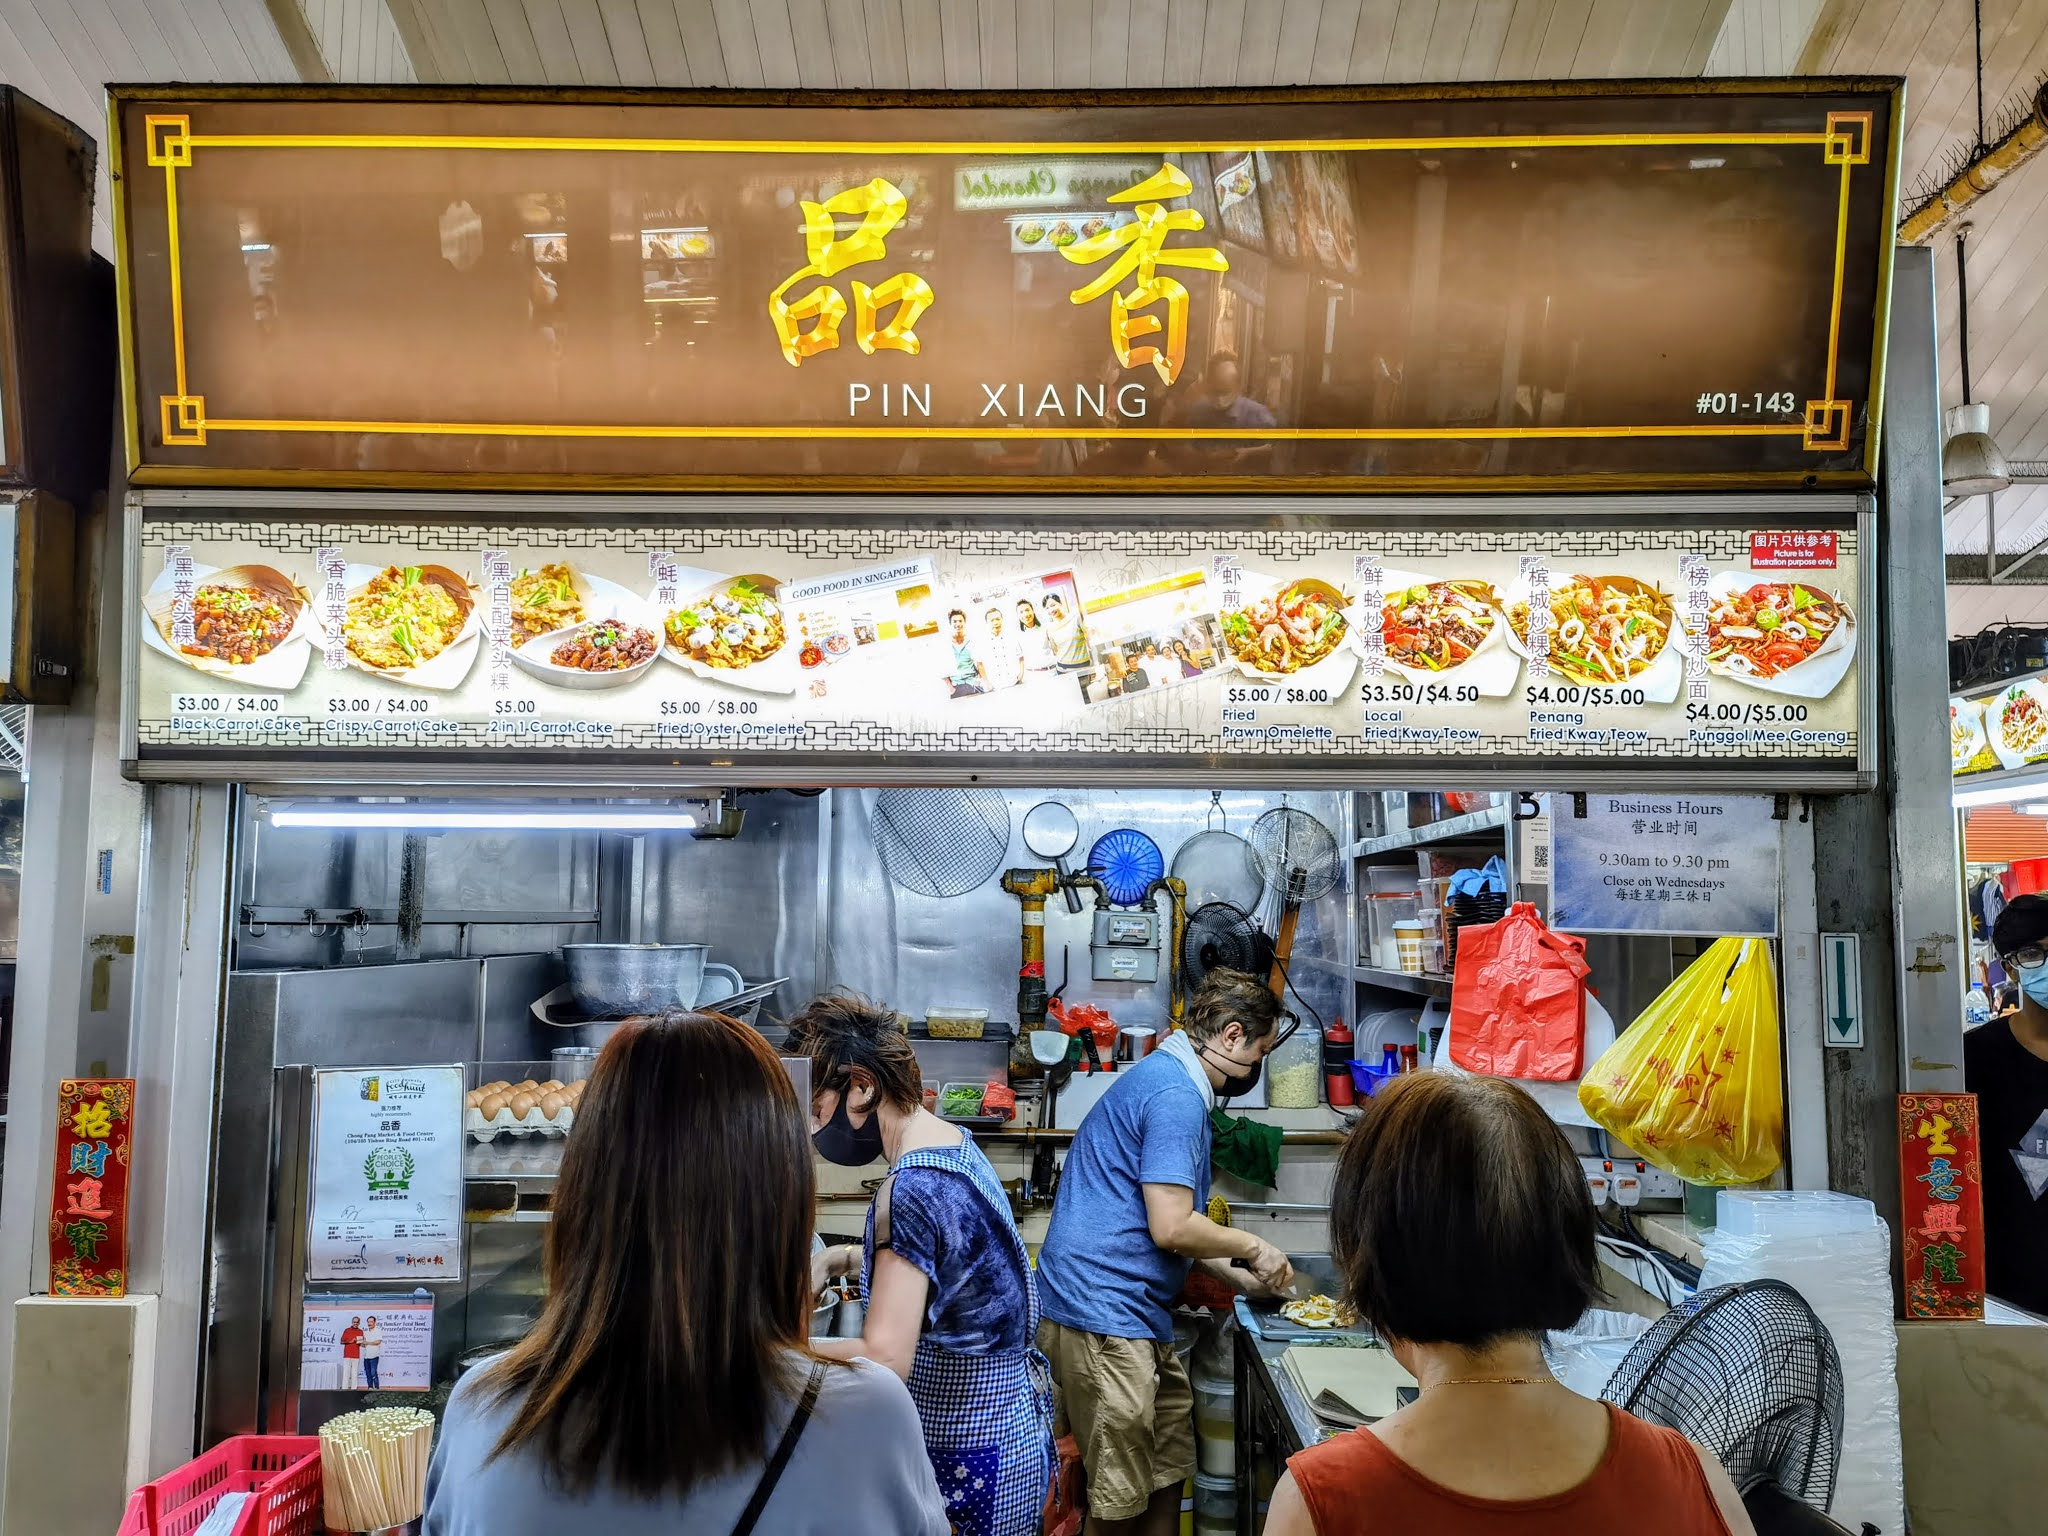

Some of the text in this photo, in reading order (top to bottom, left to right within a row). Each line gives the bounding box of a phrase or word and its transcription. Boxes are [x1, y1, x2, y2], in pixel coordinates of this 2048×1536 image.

[768, 162, 1231, 386] 品香
[848, 383, 1148, 418] PIN XIANG
[1696, 392, 1796, 414] #01-143
[1754, 534, 1833, 547] 图片只供参考
[1773, 549, 1815, 557] Picture is for
[1752, 558, 1836, 567] illustration purpose only.
[657, 562, 679, 605] 蚝煎
[792, 564, 920, 599] GOOD FOOD IN SINGAPORE
[1222, 566, 1242, 608] 虾煎
[173, 556, 196, 645] 黑菜头粿
[324, 558, 348, 667] 香脆菜头粿
[489, 561, 512, 692] 黑白配菜头粿
[1363, 566, 1384, 676] 鲜蛤炒粿条
[1528, 566, 1550, 678] 槟城炒粿条
[1687, 566, 1711, 701] 榜鹅马来炒面
[1228, 688, 1270, 702] $5.00
[1286, 688, 1328, 702] $8.00
[178, 697, 220, 712] $3.00
[237, 697, 279, 712] $4.00
[328, 698, 370, 713] $3.00
[387, 698, 429, 713] $4.00
[495, 700, 536, 714] $5.00
[660, 701, 701, 715] $5.00
[717, 701, 758, 715] $8.00
[1222, 709, 1256, 721] Fried
[1364, 710, 1402, 722] Local
[1530, 711, 1583, 725] Penang
[173, 718, 302, 732] Black Carrot Cake
[325, 719, 460, 734] Crispy Carrot Cake
[490, 721, 499, 734] 2
[501, 721, 515, 734] in
[531, 721, 575, 734] Carrot
[577, 721, 613, 734] Cake
[657, 722, 805, 737] Fried Oyster Omelette
[1222, 726, 1333, 739] Prawn Omelette
[1364, 727, 1480, 742] Fried Kway Teow
[1530, 728, 1649, 743] Fried Kway Teow
[1689, 729, 1847, 745] Punggol Mee Goreng
[1608, 799, 1723, 816] Business Hours
[1631, 820, 1698, 836] 营业时间
[1599, 853, 1730, 872] 9.30am to 9.30 pm
[1603, 875, 1725, 891] Close on Wednesdays
[1614, 888, 1712, 903] 每逢星期三休日
[380, 1120, 401, 1131] 品香
[375, 1160, 404, 1168] CHOICE
